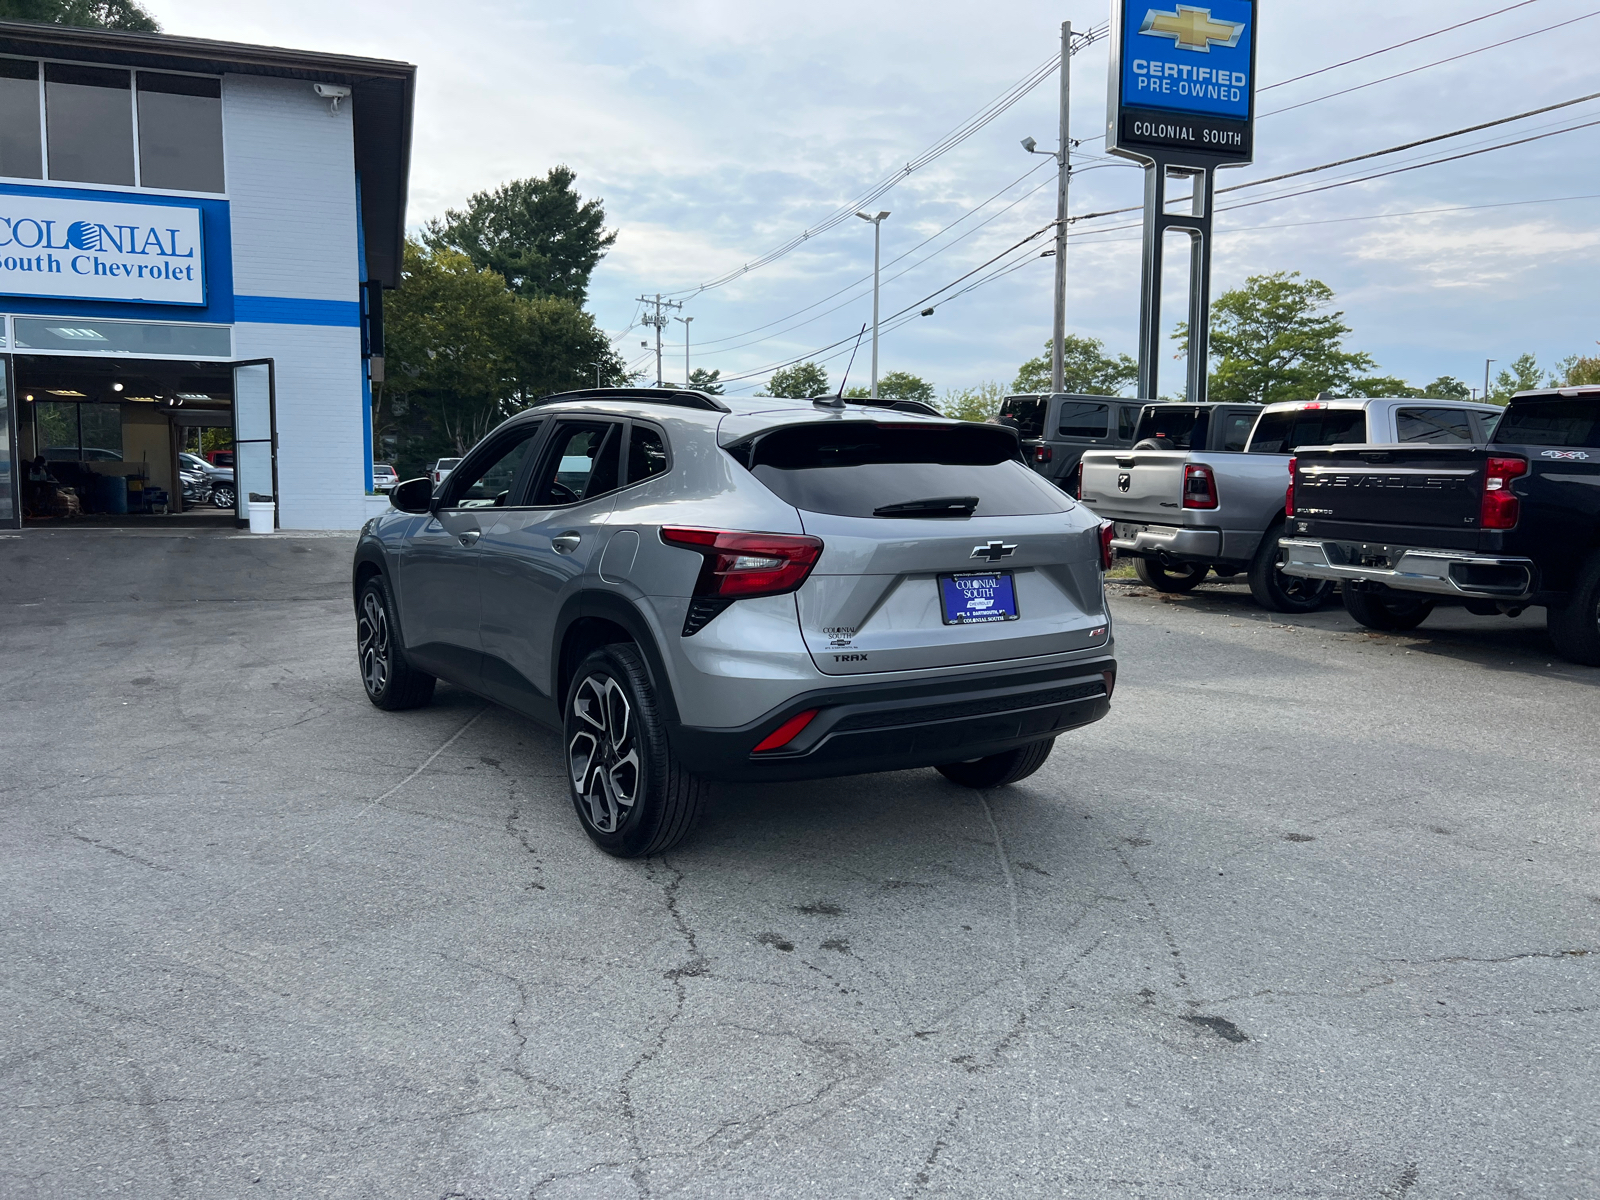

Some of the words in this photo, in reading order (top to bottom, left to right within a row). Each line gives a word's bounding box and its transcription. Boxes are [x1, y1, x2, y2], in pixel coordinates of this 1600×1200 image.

[1132, 58, 1246, 87] CERTIFIED
[1138, 76, 1240, 102] PRE-OWNED
[1134, 121, 1195, 141] COLONIAL
[1203, 129, 1241, 146] SOUTH
[71, 255, 194, 281] Chevrolet
[956, 579, 999, 589] COLONIAL
[964, 589, 993, 598] SOUTH
[833, 653, 868, 663] TRAX
